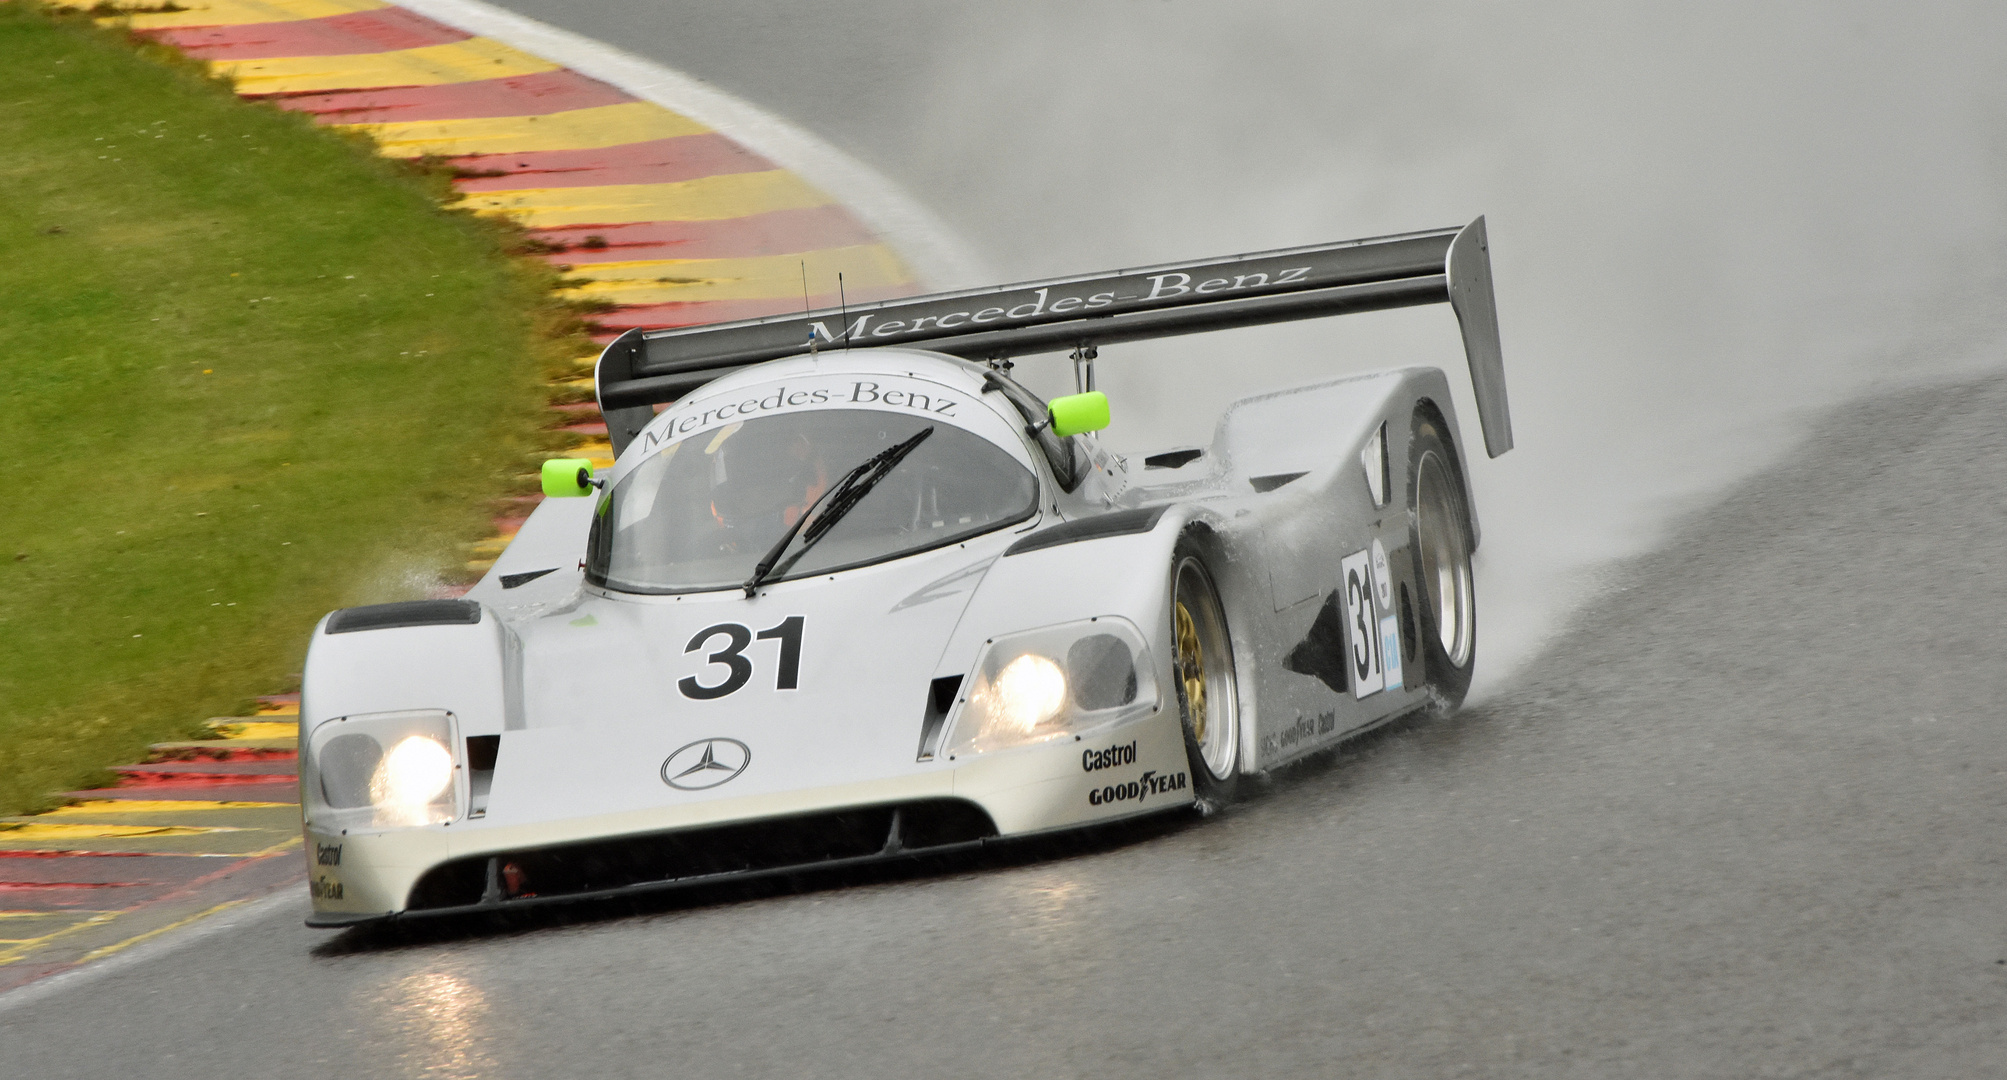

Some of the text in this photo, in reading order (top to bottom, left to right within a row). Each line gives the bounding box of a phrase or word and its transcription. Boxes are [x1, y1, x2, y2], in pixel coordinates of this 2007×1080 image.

[799, 266, 1312, 348] Mercedes-Benz
[641, 381, 958, 455] Mercedes-Benz
[676, 615, 806, 701] 31
[1348, 563, 1381, 682] 31
[1082, 740, 1137, 772] Castrol
[1088, 770, 1187, 806] GOODYEAR
[317, 842, 343, 867] Castrol
